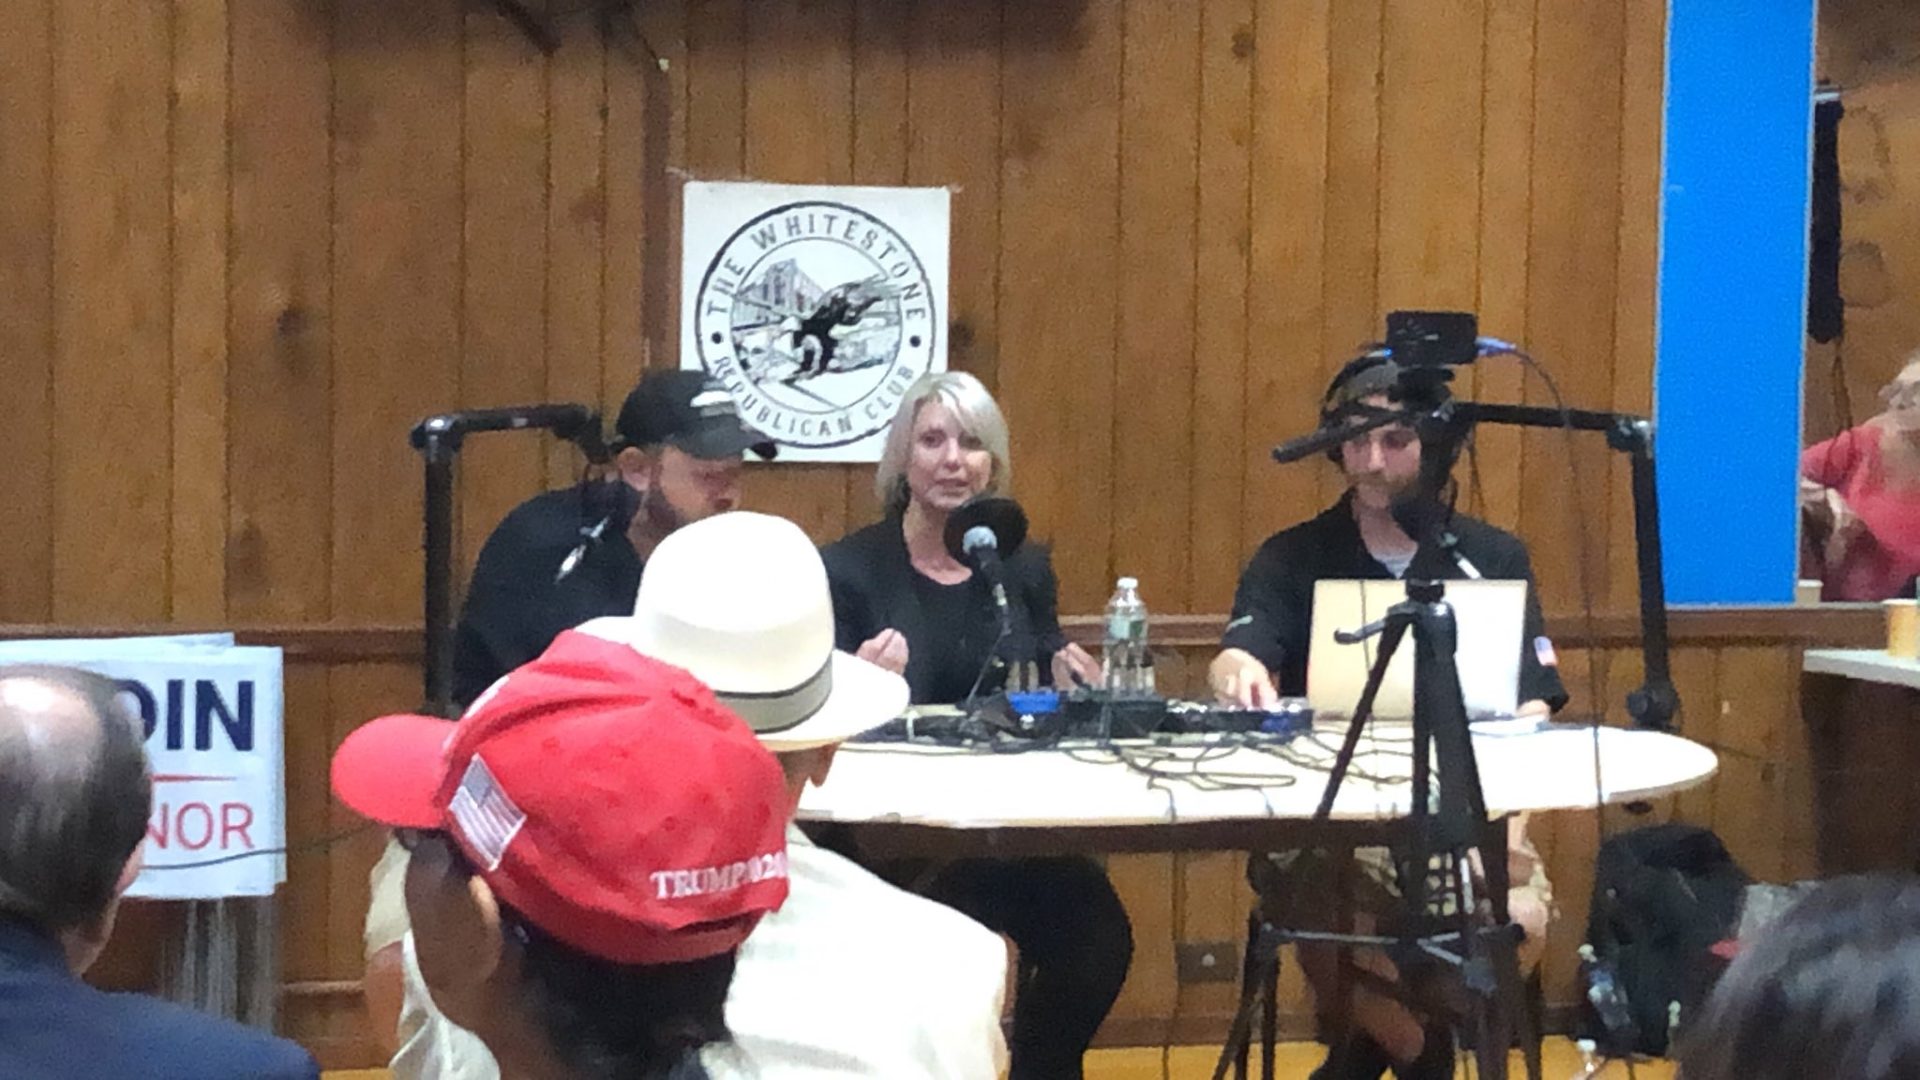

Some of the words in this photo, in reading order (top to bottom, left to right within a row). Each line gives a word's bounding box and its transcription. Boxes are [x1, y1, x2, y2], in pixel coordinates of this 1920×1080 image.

[707, 258, 745, 317] THE
[750, 213, 926, 320] WHITESTONE
[714, 356, 853, 437] REPUBLICAN
[865, 365, 914, 421] CLUB
[650, 861, 746, 899] TRUMP
